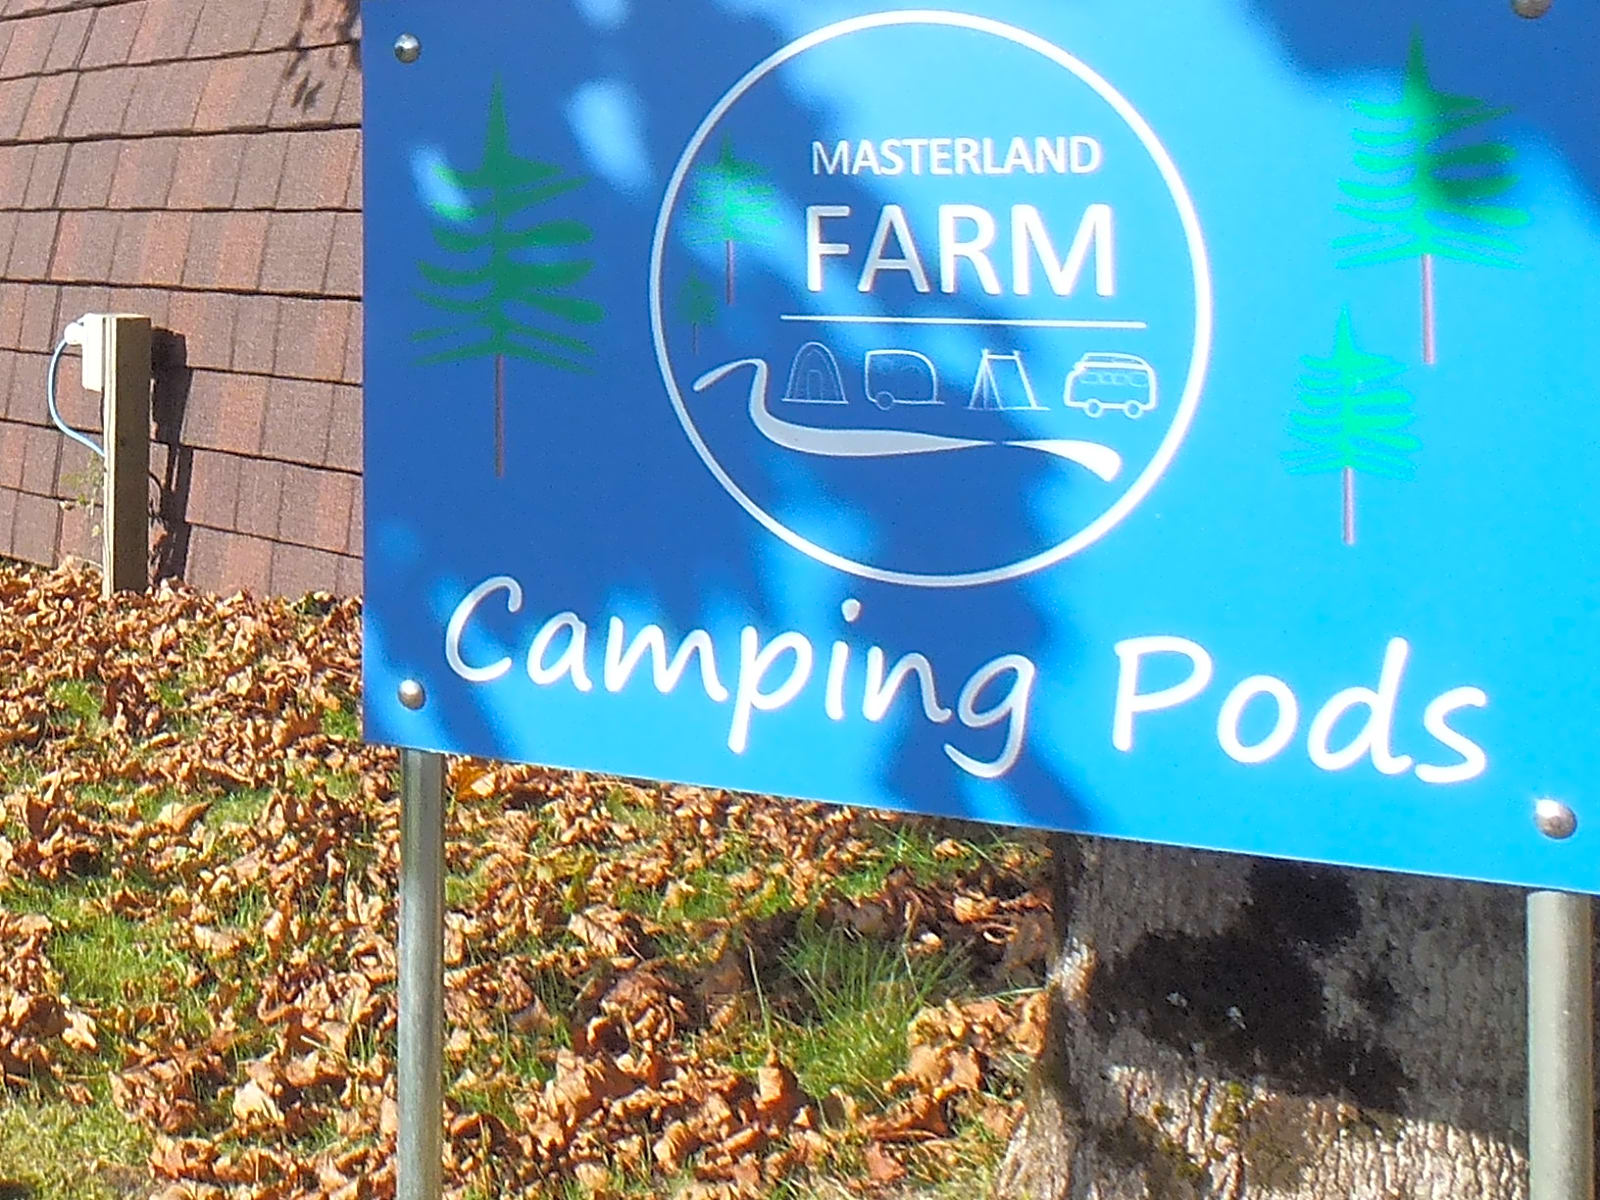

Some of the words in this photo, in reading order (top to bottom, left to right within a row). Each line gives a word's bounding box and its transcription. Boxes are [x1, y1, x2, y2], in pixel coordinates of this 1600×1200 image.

[812, 136, 1102, 175] MASTERLAND
[805, 203, 1115, 297] FARM
[443, 575, 1034, 779] Camping
[1111, 635, 1489, 785] Pods
